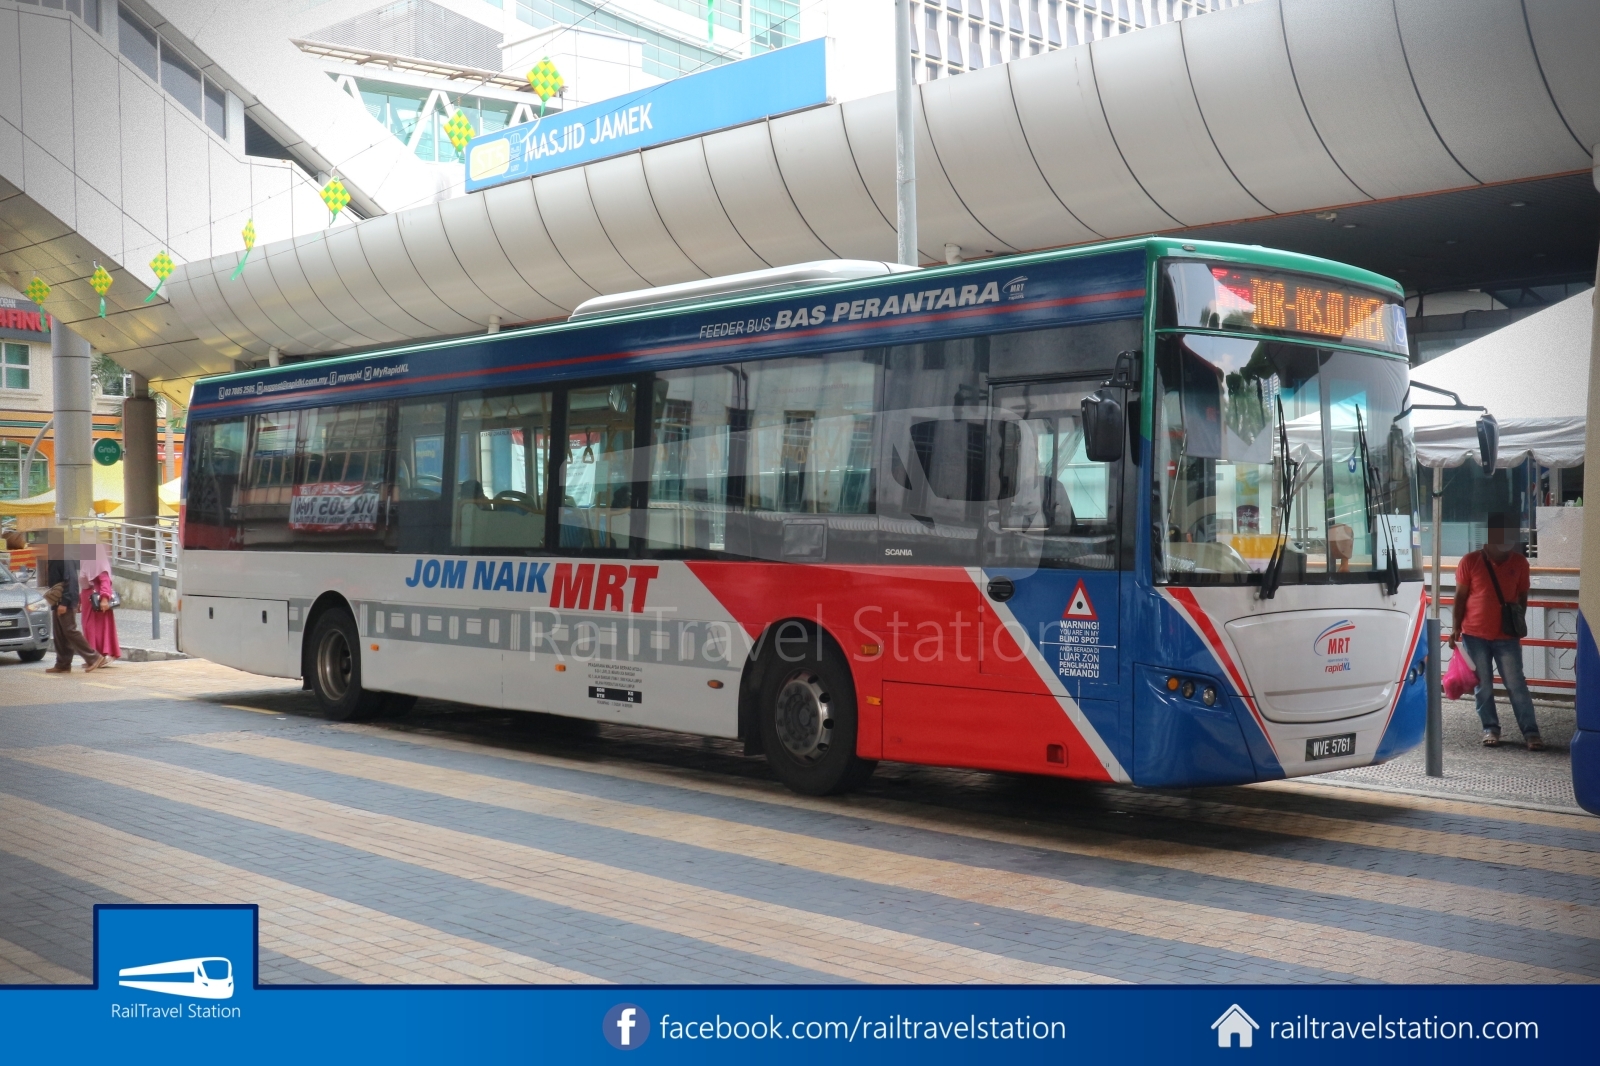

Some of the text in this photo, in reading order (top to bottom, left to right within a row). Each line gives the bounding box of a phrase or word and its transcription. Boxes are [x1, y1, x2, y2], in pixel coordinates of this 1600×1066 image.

[524, 103, 653, 162] MASJID JAMEK
[699, 281, 1000, 339] FEEDER BUS BAS PERANTARA
[338, 369, 363, 382] myrapid
[885, 548, 913, 556] SCANIA
[405, 559, 660, 614] JOM NAIK MRT
[1060, 620, 1100, 630] WARNING!
[1060, 635, 1099, 644] BLIND SPOT
[1327, 637, 1350, 655] MRT
[1060, 653, 1099, 663] LUAR ZON
[1060, 661, 1099, 670] PENGLIHATAN
[1325, 662, 1351, 674] rapidKL
[1060, 668, 1099, 678] PEMANDU
[1313, 737, 1350, 757] WVE 5761
